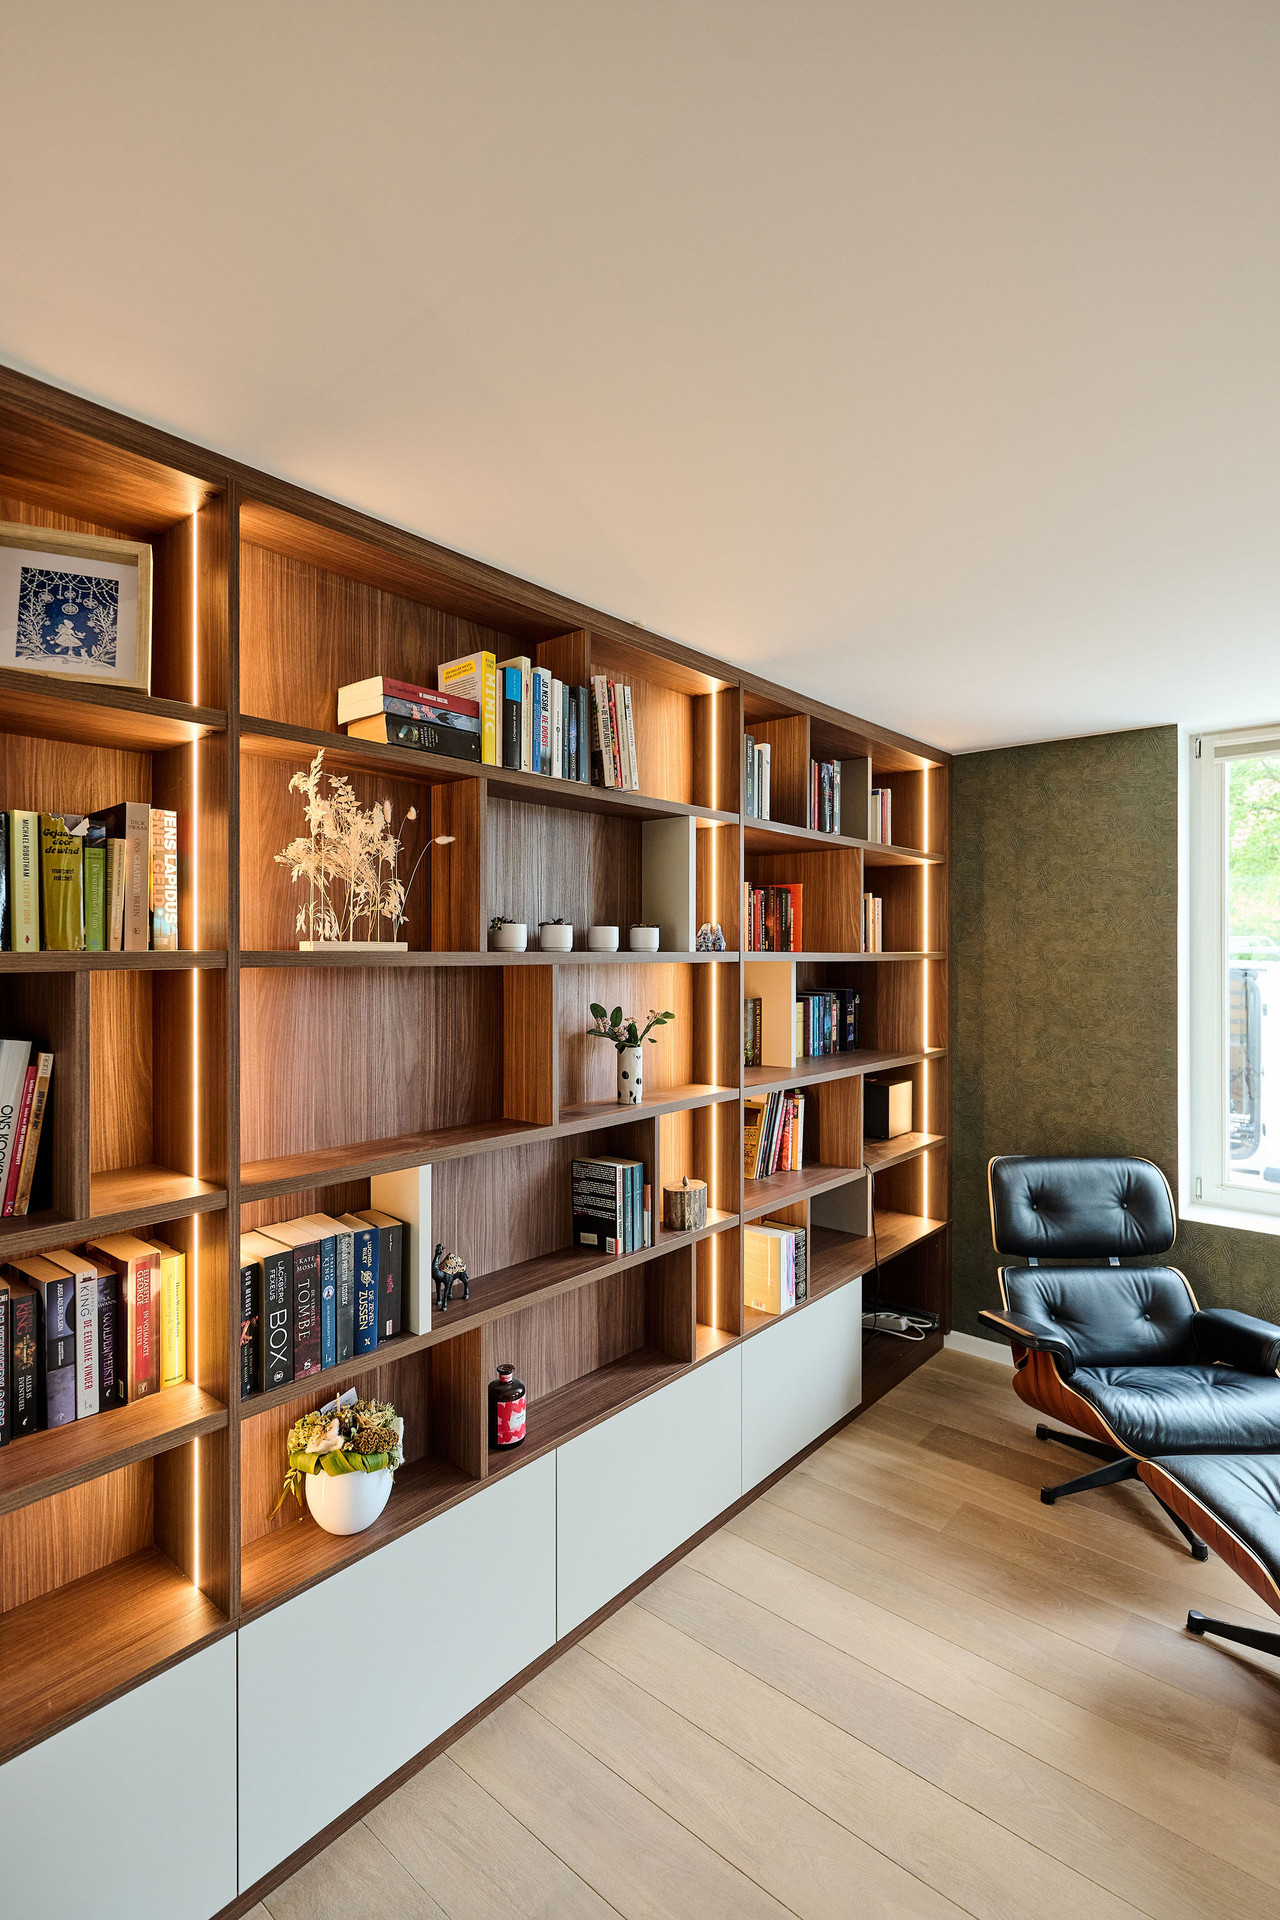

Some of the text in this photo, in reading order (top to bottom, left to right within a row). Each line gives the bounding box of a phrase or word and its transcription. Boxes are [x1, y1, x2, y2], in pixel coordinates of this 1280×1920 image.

[541, 678, 549, 689] JO
[485, 673, 495, 735] MIMIC
[541, 715, 549, 725] DE
[541, 725, 549, 748] DORST
[22, 819, 30, 844] MICHAEL
[22, 845, 30, 878] ROBOTHAM
[153, 809, 165, 908] SNEL GELD
[164, 810, 177, 925] JENS LAPIDUS
[23, 880, 31, 899] LEVEN
[755, 1006, 761, 1015] DE
[0, 1105, 14, 1130] ONS
[80, 1285, 90, 1317] KING
[136, 1270, 144, 1307] GEORGE
[310, 1289, 316, 1297] DE
[368, 1290, 374, 1300] DE
[16, 1302, 28, 1336] KING
[143, 1309, 149, 1319] IN
[298, 1279, 310, 1342] TOMBE
[359, 1290, 368, 1330] ZUSSEN
[269, 1309, 288, 1369] BOX
[83, 1319, 93, 1391] DE EERLIJKE VINDER
[25, 1374, 33, 1392] ALLES
